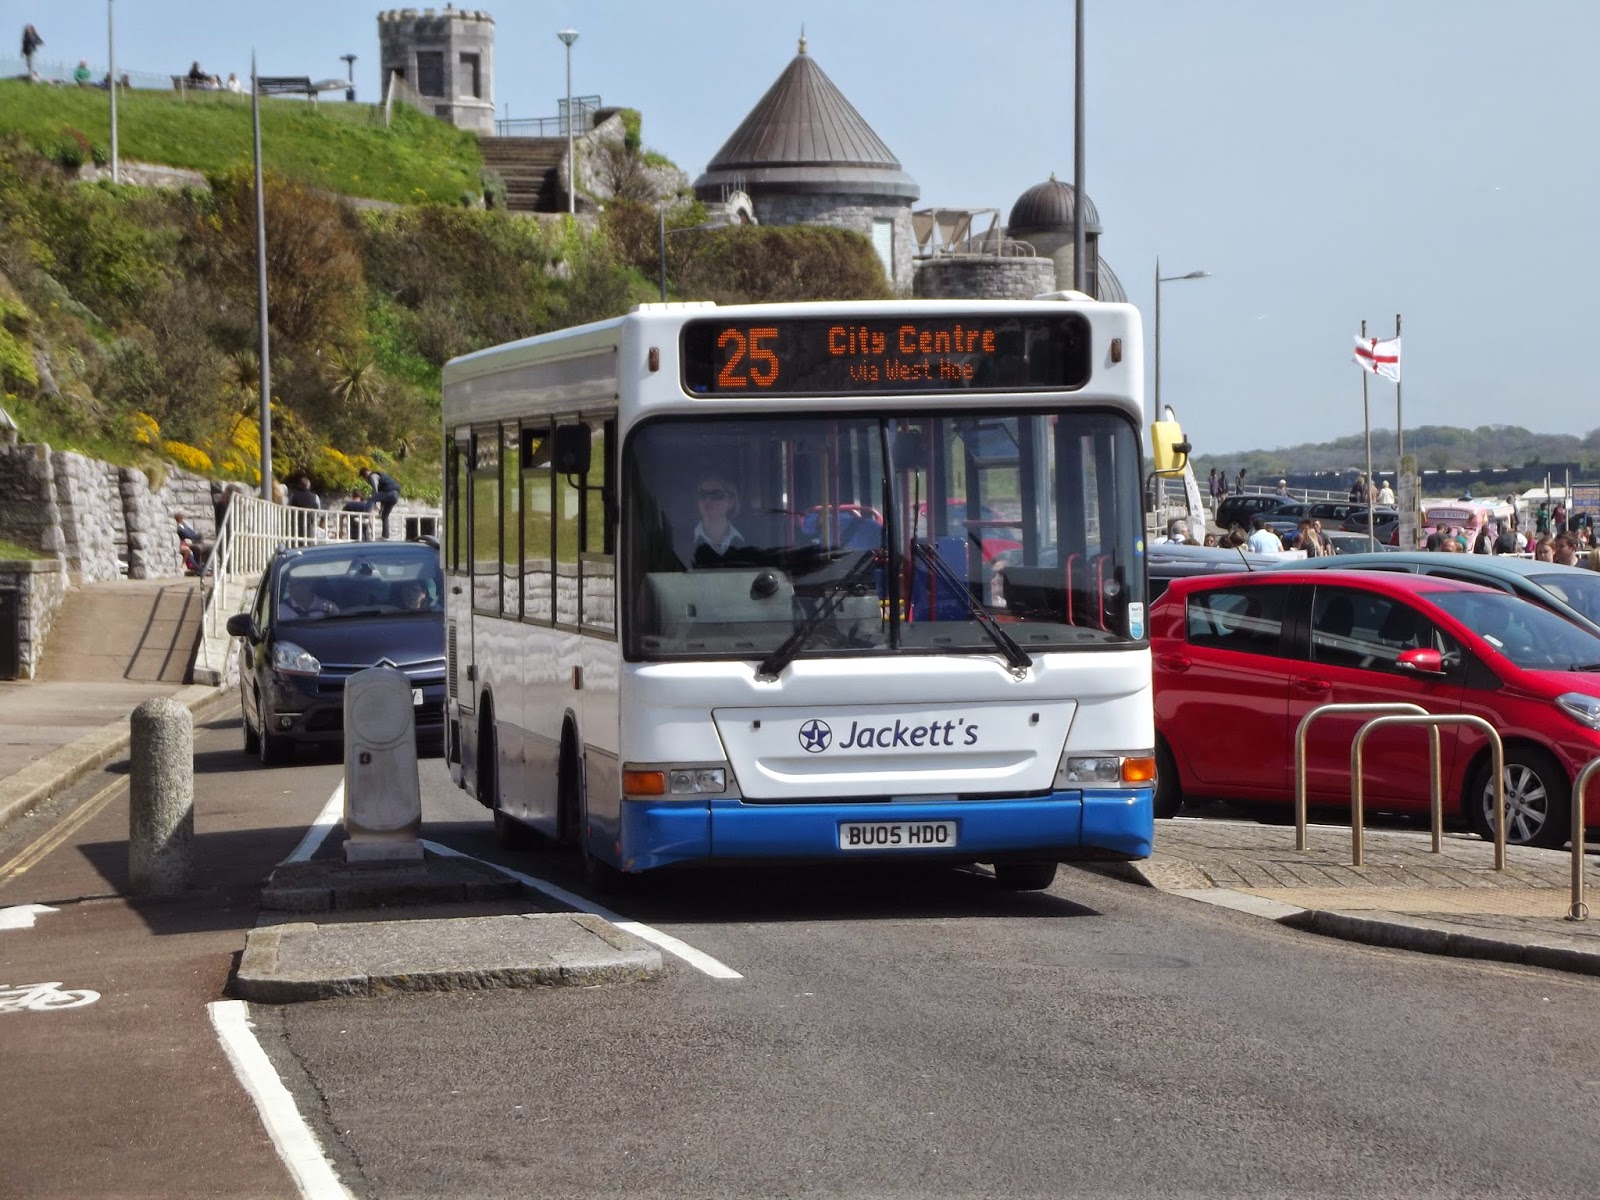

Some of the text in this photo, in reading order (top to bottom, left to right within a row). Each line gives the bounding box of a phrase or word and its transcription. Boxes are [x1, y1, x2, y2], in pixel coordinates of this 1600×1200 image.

[829, 325, 995, 356] City Centre
[718, 328, 779, 387] 25
[850, 357, 974, 383] via West Hoe
[839, 717, 979, 749] Jackett's
[848, 824, 949, 846] BU05 HDO
